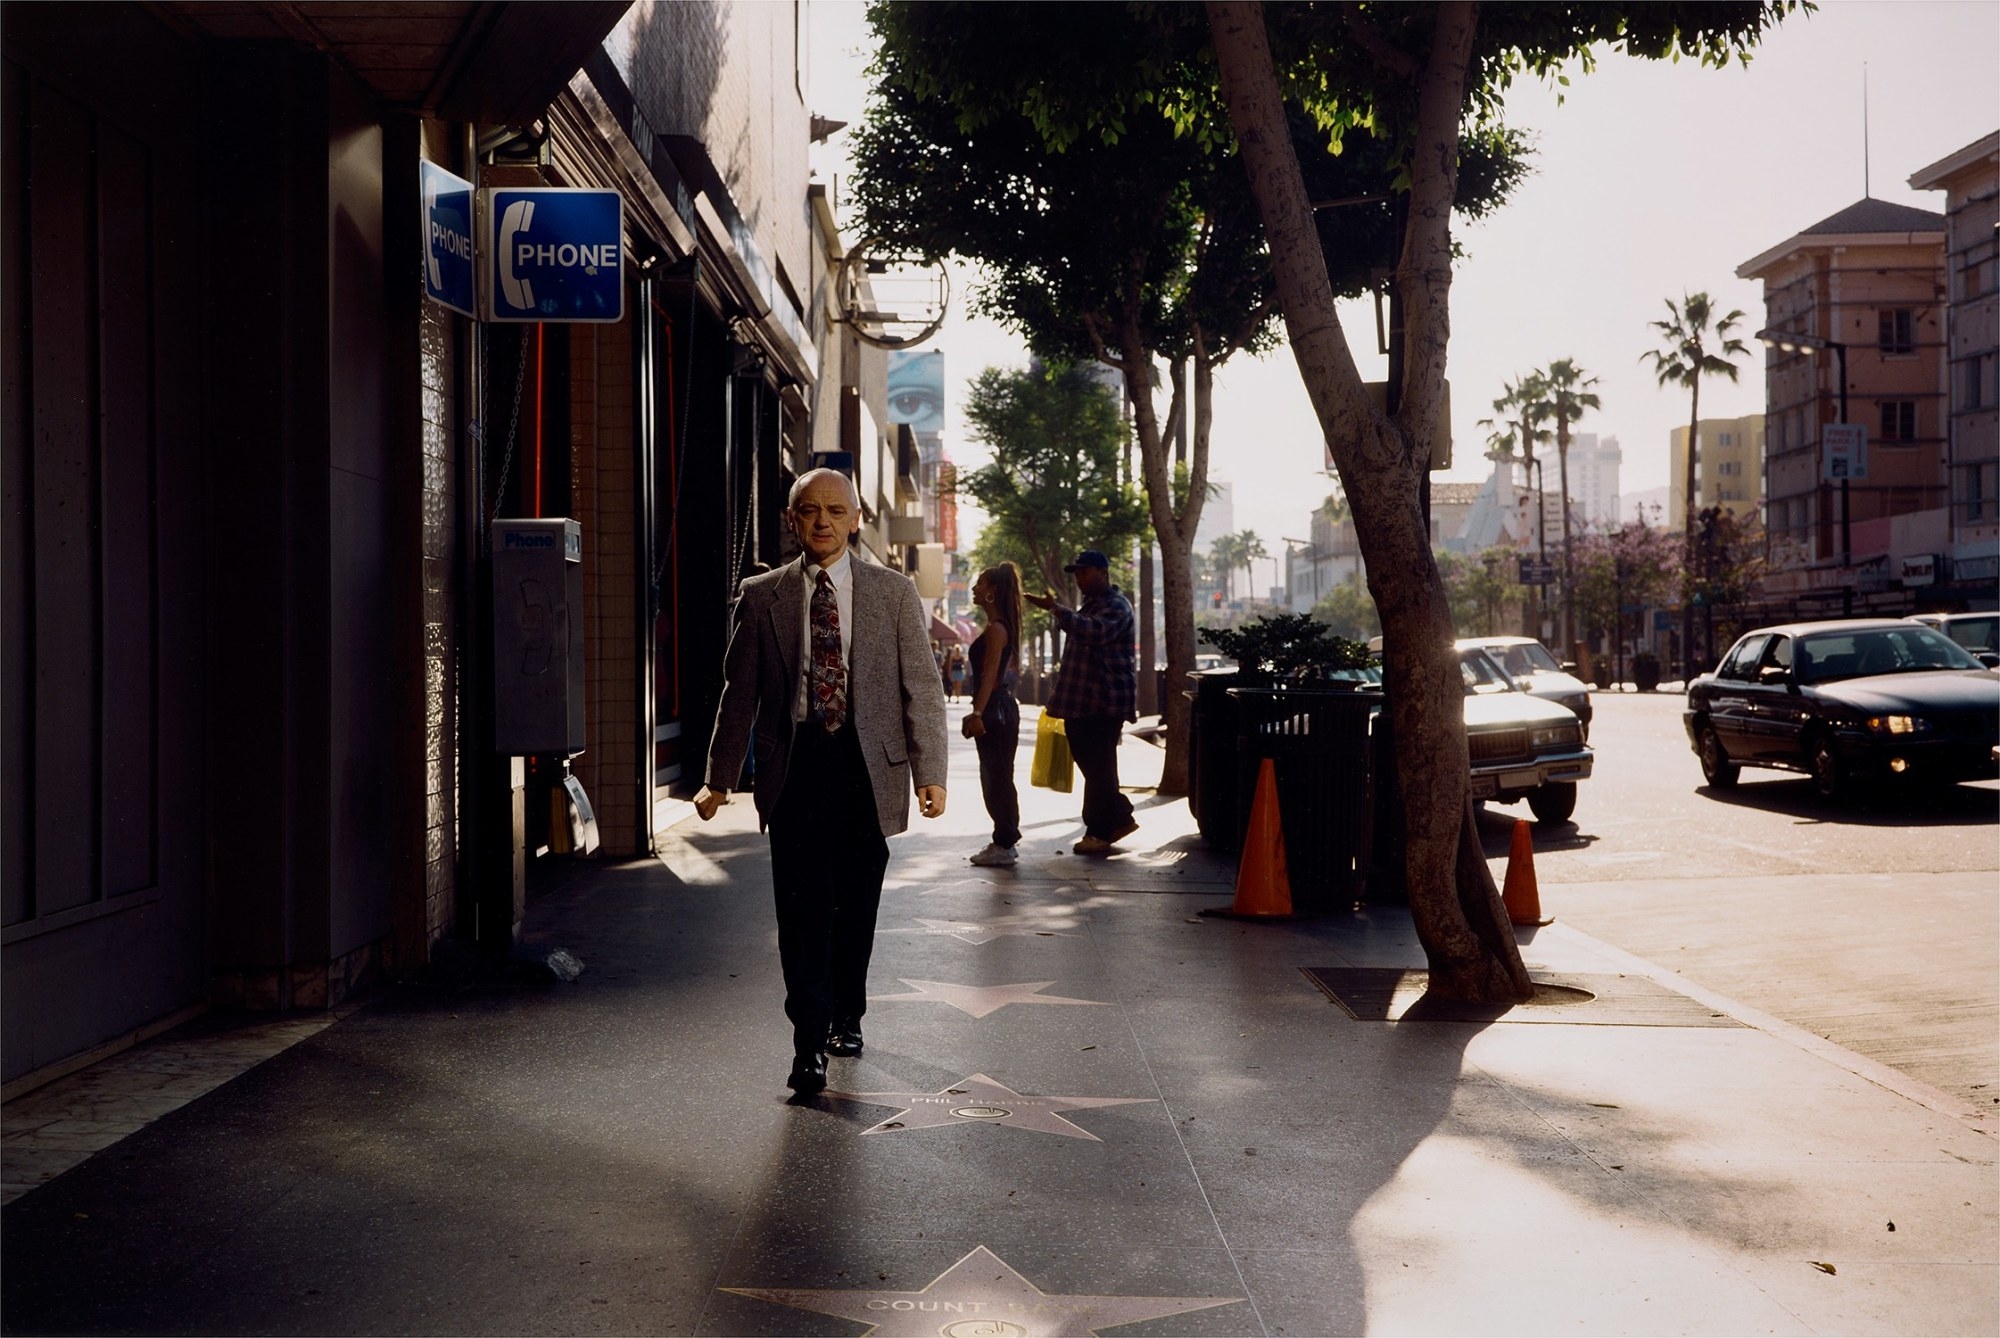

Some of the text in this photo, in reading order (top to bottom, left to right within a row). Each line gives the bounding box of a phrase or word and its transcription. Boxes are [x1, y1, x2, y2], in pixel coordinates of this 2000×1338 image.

[432, 220, 471, 261] PHONE
[518, 243, 618, 267] PHONE
[505, 532, 554, 548] Phone
[866, 1300, 988, 1313] COUNT
